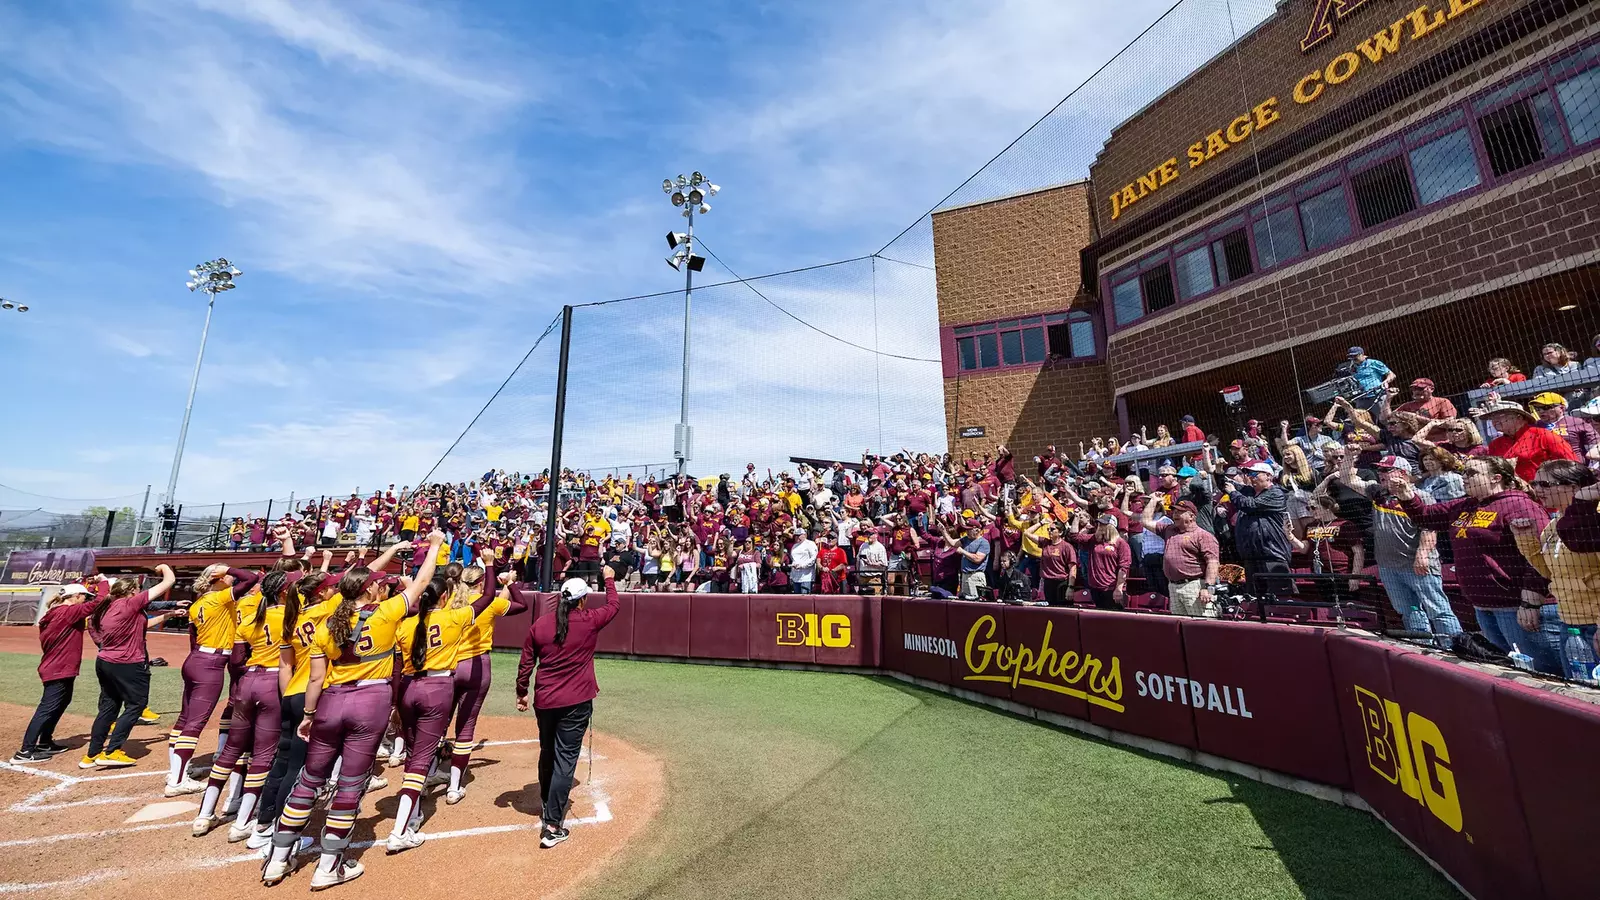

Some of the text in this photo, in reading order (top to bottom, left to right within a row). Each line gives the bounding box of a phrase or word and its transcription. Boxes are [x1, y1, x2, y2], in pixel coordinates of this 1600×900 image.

[1109, 157, 1180, 220] JANE
[1187, 96, 1280, 168] SAGE
[198, 606, 205, 624] 4
[264, 625, 273, 646] 1
[295, 621, 316, 648] 18
[358, 626, 374, 651] 5
[904, 614, 1253, 718] MINNESOTA Gophers SOFTBALL
